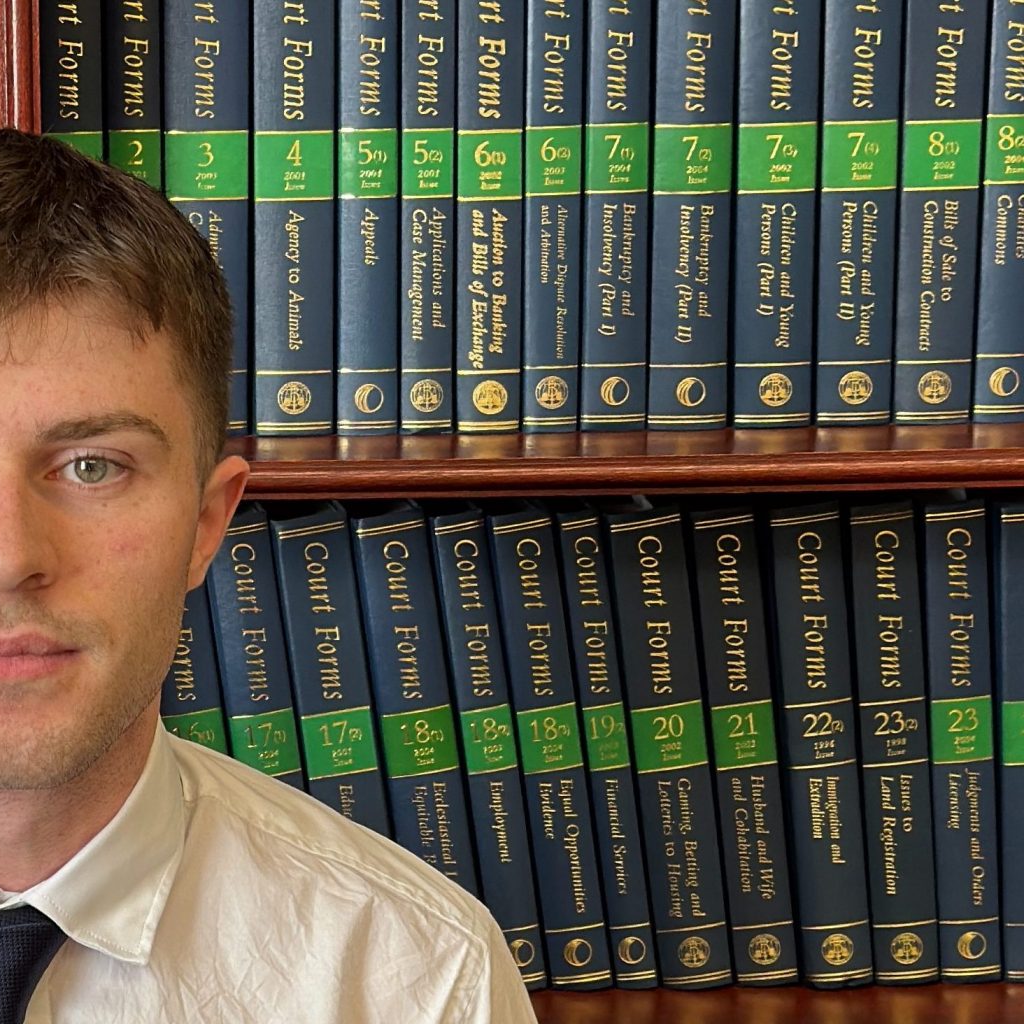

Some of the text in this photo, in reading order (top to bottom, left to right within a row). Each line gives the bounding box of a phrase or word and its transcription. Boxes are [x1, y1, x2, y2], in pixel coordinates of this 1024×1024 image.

[283, 37, 312, 120] Forms
[543, 32, 570, 113] Forms
[198, 142, 214, 167] 3
[286, 140, 302, 166] 4
[358, 140, 387, 165] 5(1)
[413, 140, 443, 165] 5(2)
[360, 208, 379, 265] Appeals
[428, 207, 447, 328] Applications and
[598, 203, 618, 335] Insolvency (Part I)
[618, 203, 636, 316] Bankruptcy and
[841, 201, 858, 253] Persons
[938, 200, 959, 301] Bills of Sale to
[285, 210, 305, 350] Agency to Animals
[407, 209, 427, 341] Case Management
[468, 209, 489, 369] and Bills of Exchange
[488, 208, 508, 354] Auction to Banking
[837, 261, 856, 295] (Part
[855, 201, 878, 346] Children and Young
[919, 200, 939, 351] Construction Contracts
[383, 541, 423, 699] Court Forms
[798, 532, 827, 688] Court Forms
[653, 714, 684, 740] 20
[728, 712, 758, 738] 21
[948, 708, 978, 732] 23
[489, 782, 512, 862] Employment
[731, 778, 754, 892] and Cohabitation
[750, 776, 776, 899] Husband and Wife
[809, 778, 825, 838] Extradition
[824, 776, 846, 863] Immigration and
[880, 776, 899, 894] Land Registration
[900, 774, 913, 832] Issues to
